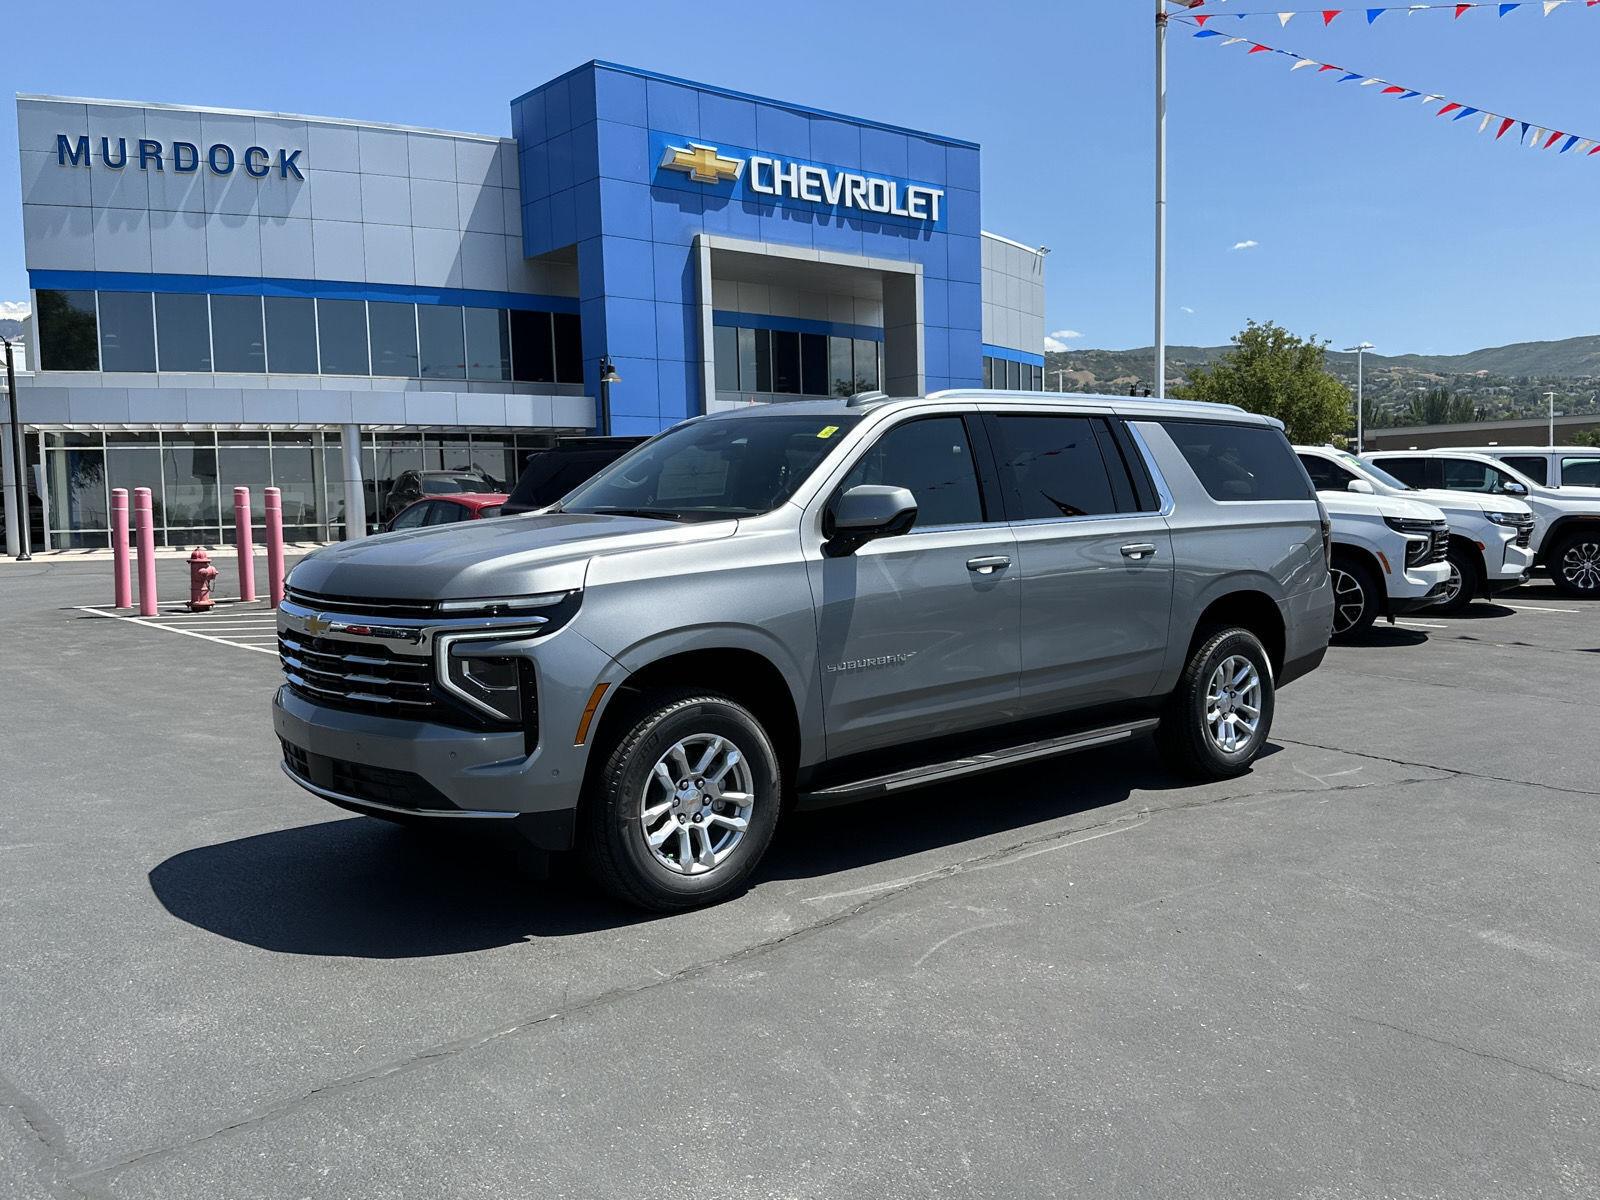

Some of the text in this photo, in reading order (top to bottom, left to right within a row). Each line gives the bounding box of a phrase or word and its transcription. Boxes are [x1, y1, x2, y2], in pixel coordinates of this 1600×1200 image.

[57, 134, 305, 181] MURDOCK
[750, 156, 945, 221] CHEVROLET
[826, 652, 917, 673] SUBURBAN
